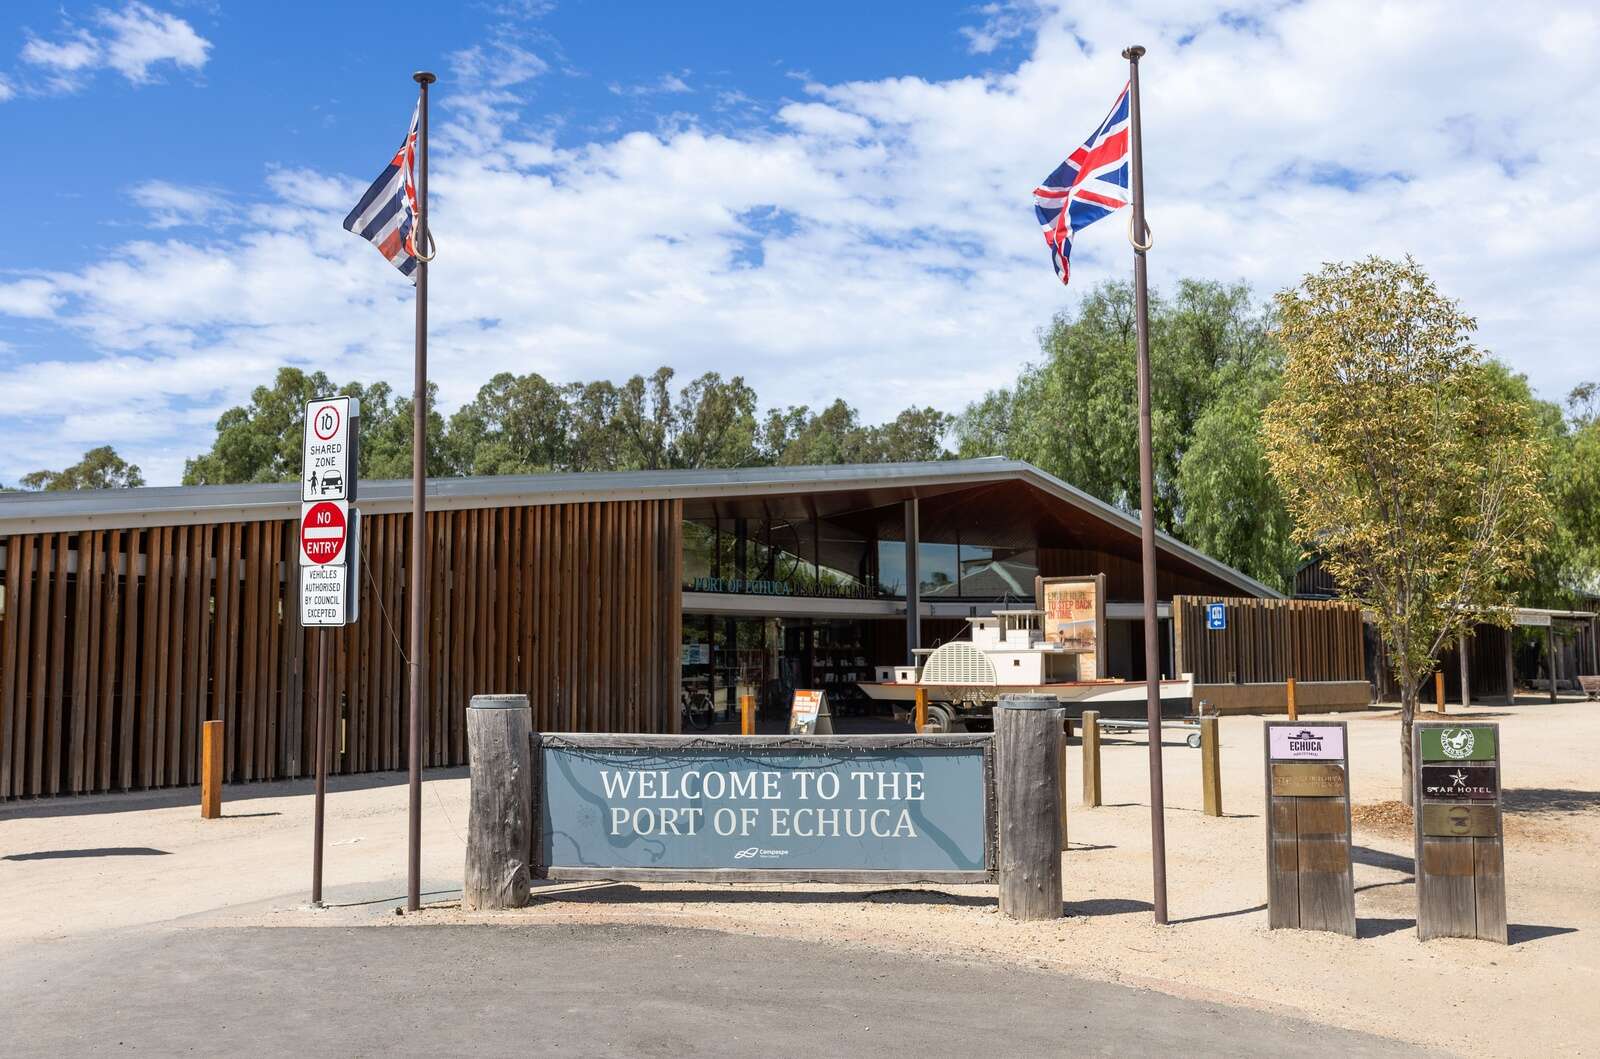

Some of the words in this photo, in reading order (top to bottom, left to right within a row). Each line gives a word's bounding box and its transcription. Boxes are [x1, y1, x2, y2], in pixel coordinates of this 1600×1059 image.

[321, 414, 333, 431] 10
[310, 444, 342, 456] SHARED
[315, 457, 336, 468] ZONE
[317, 512, 331, 524] NO
[307, 542, 338, 554] ENTRY
[309, 570, 337, 579] VEHICLES
[304, 582, 341, 592] AUTHORISED
[304, 595, 312, 605] BY
[314, 595, 340, 605] COUNCIL
[307, 608, 337, 618] EXCEPTED
[1290, 741, 1322, 751] ECHUCA
[600, 771, 781, 799] WELCOME
[792, 771, 840, 800] TO
[851, 771, 925, 801] THE
[1458, 786, 1492, 794] HOTEL
[610, 807, 703, 836] PORT
[713, 808, 759, 836] OF
[770, 808, 918, 838] ECHUCA
